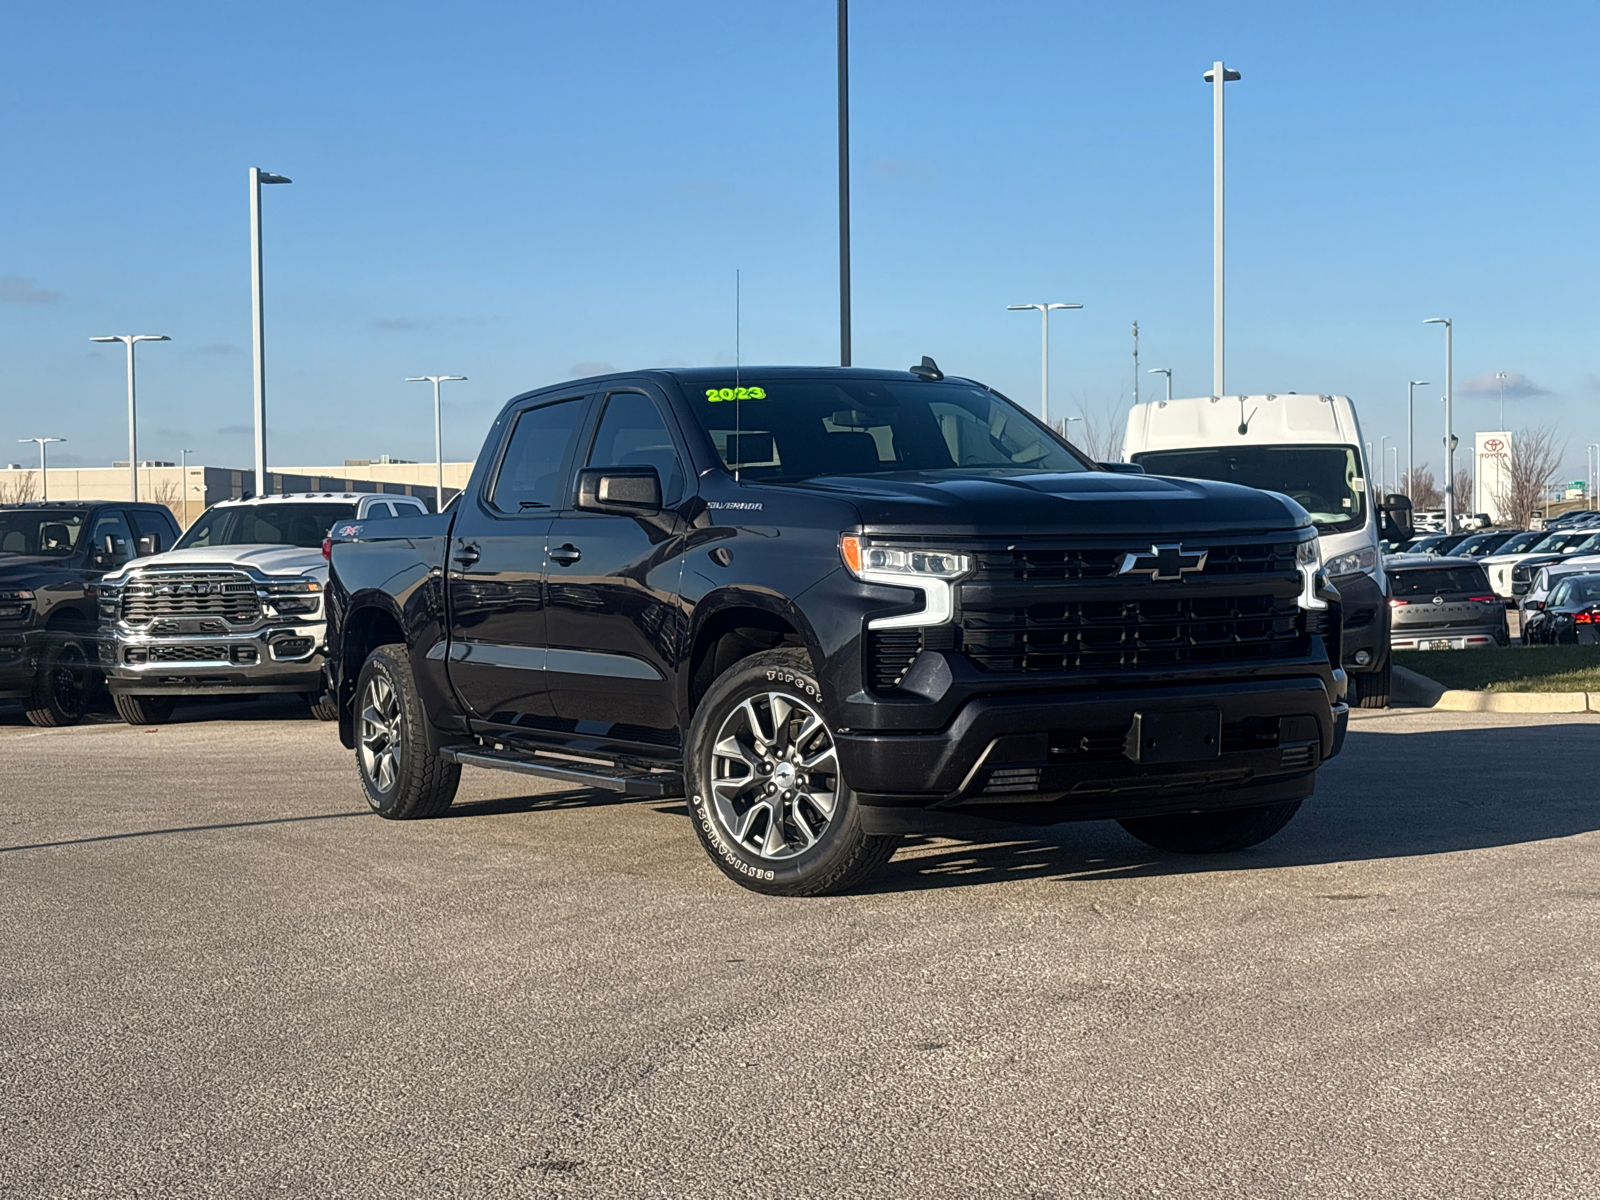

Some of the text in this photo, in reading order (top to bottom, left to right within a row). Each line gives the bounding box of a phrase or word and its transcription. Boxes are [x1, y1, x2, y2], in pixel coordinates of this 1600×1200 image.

[705, 386, 767, 402] 2023
[706, 501, 764, 511] SILVERADO
[1398, 605, 1480, 614] PATHFINDER
[697, 807, 775, 881] DESTINATION
